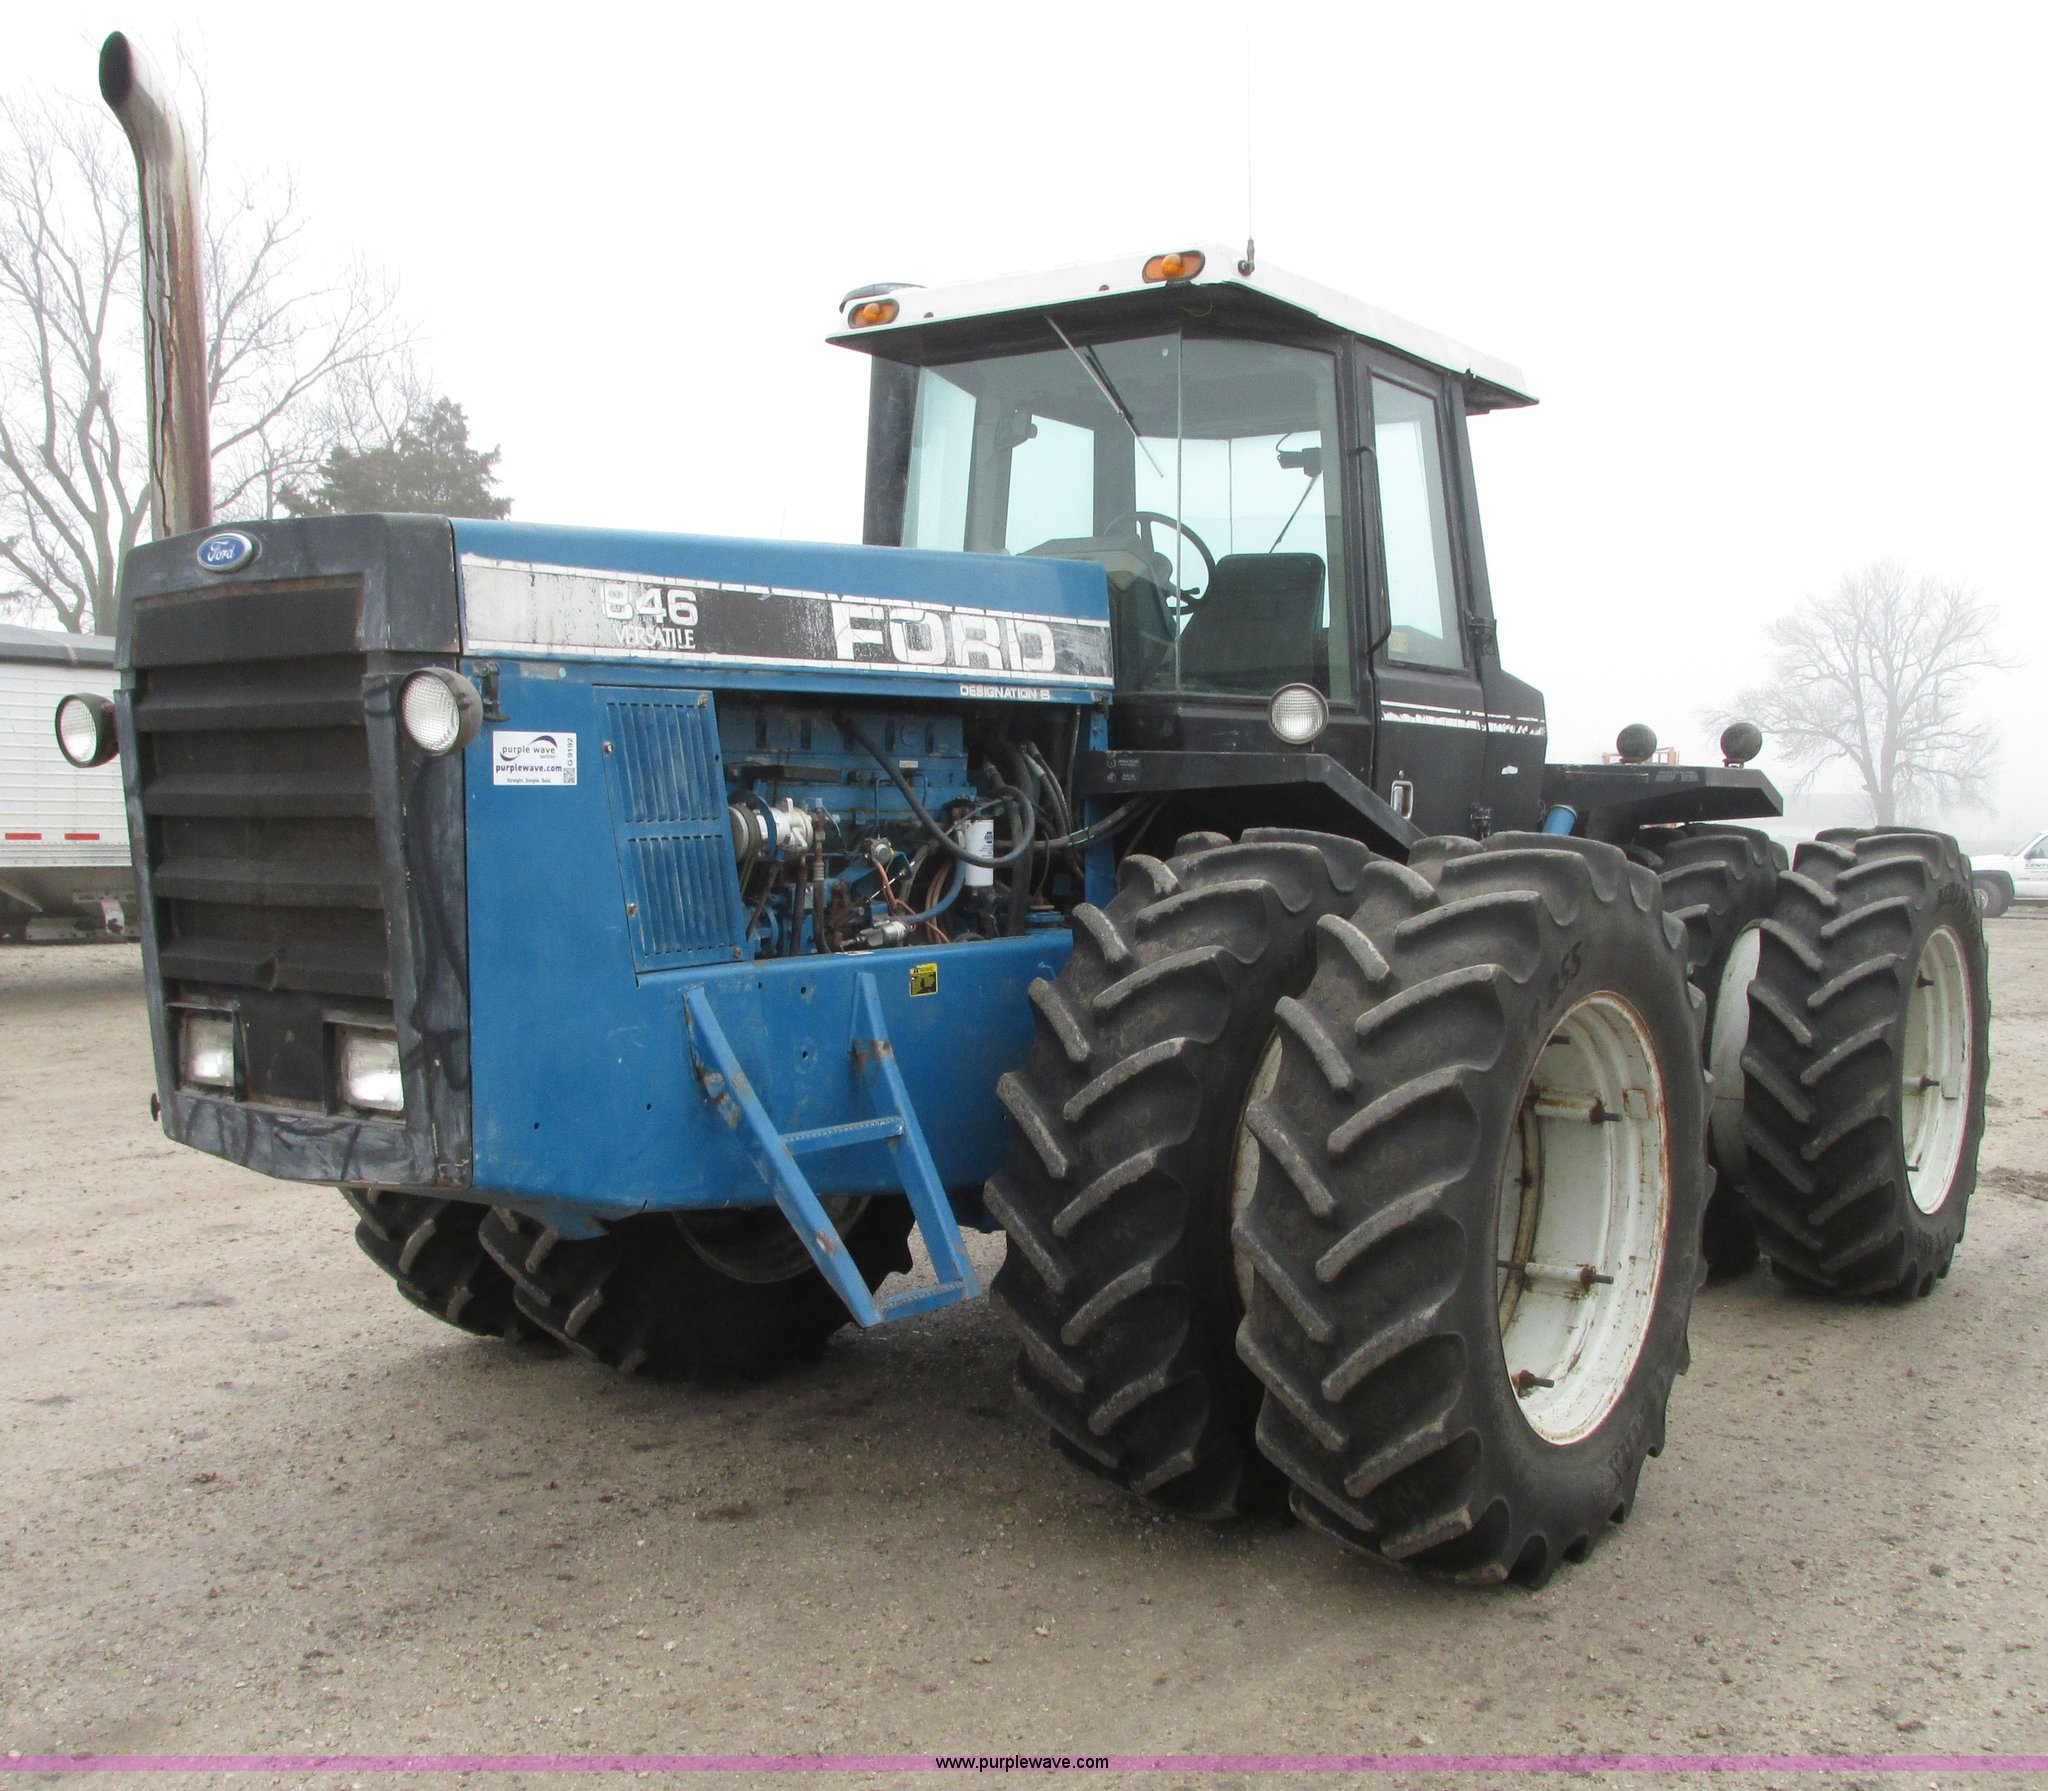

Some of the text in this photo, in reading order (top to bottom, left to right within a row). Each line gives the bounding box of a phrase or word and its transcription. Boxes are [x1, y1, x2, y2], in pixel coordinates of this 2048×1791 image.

[207, 540, 236, 562] Ford
[601, 583, 699, 627] 846
[614, 624, 696, 650] VERSATILE
[831, 602, 1056, 673] FORD
[960, 684, 1037, 699] DESIGNATION
[502, 745, 556, 755] purple wave
[495, 763, 562, 774] purplewave.com
